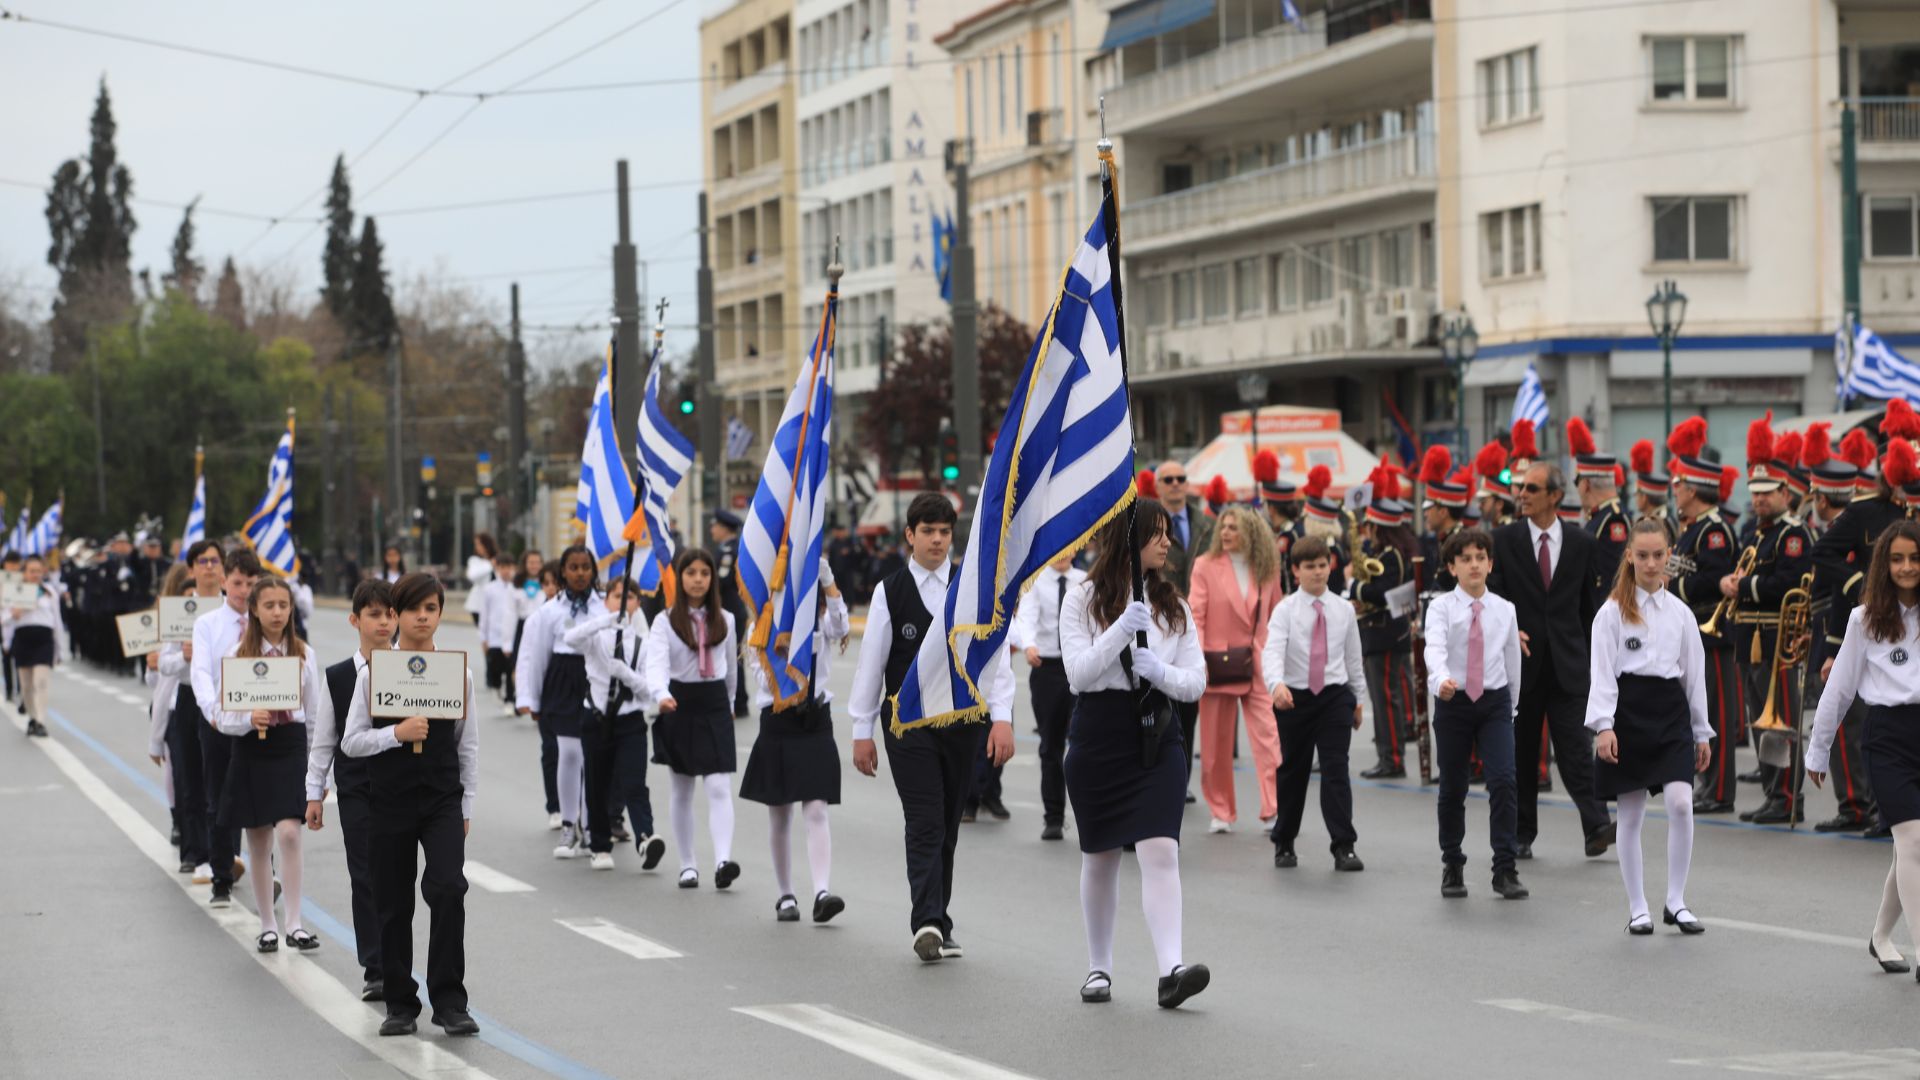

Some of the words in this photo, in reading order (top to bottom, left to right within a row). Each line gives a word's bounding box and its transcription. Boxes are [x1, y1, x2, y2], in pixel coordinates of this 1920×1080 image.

[906, 111, 925, 272] AMALIA
[249, 694, 298, 703] ΔΗΜΟΤΙΚΟ
[403, 698, 462, 709] ΔΗΜΟΤΙΚΟ
